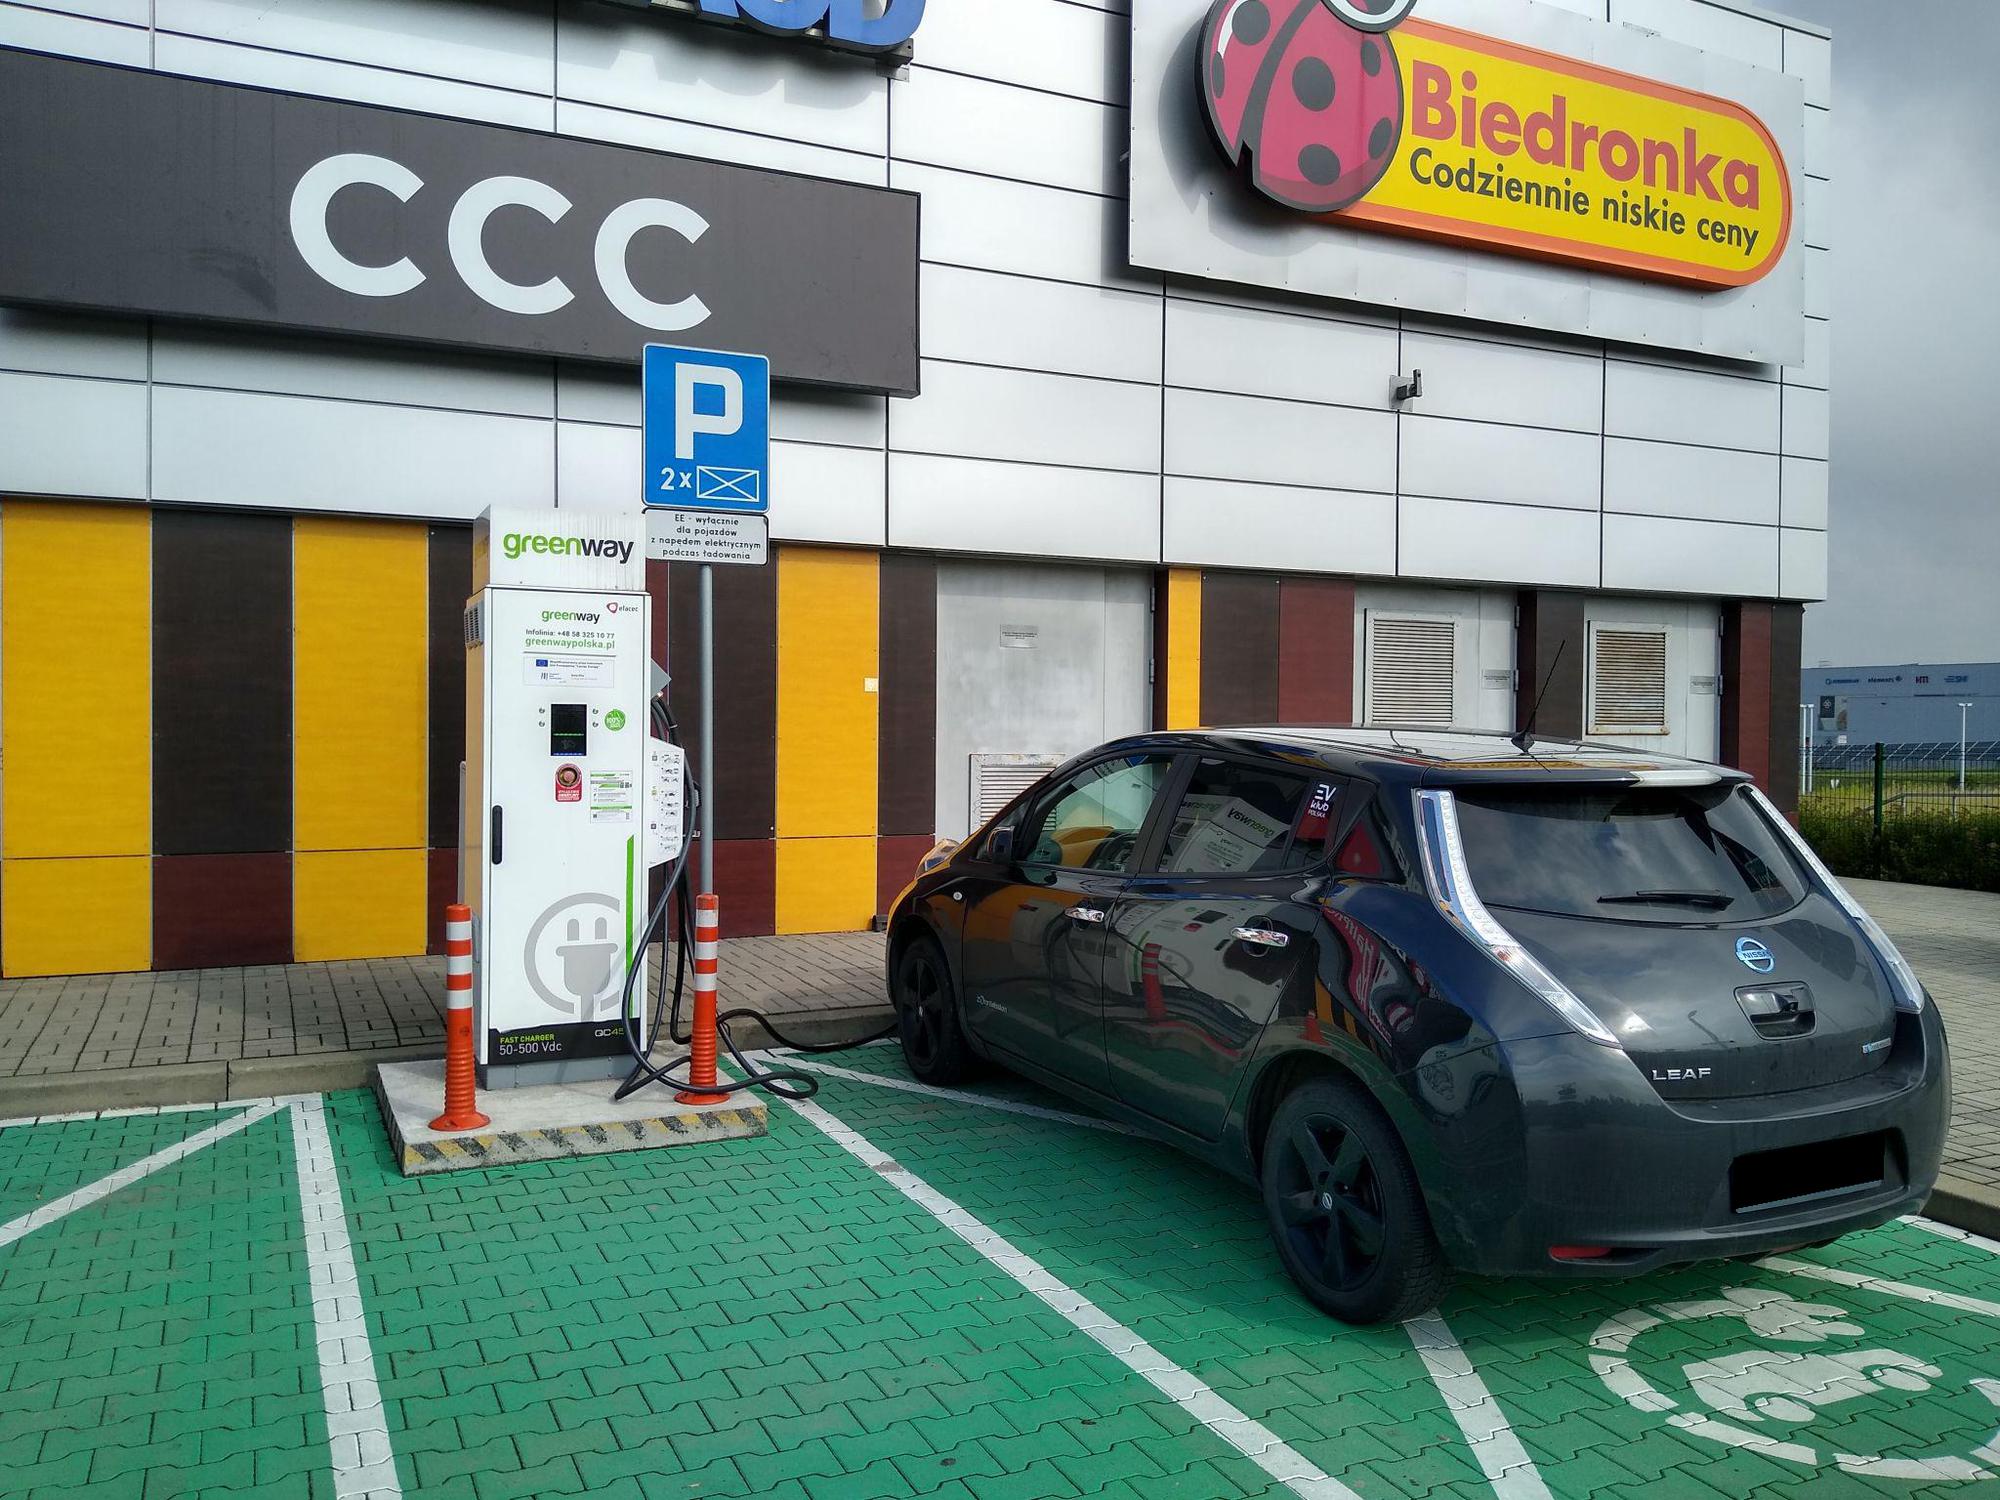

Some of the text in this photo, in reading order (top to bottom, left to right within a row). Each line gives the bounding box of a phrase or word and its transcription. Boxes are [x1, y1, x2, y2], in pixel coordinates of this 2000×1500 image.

[1411, 59, 1760, 211] Biedronka
[1410, 147, 1760, 256] Codziennie niskie ceny
[289, 153, 712, 332] CCC
[675, 362, 744, 460] P
[674, 514, 685, 522] EE
[695, 516, 739, 526] wyłącznie
[676, 526, 691, 534] dla
[503, 533, 635, 564] greenway
[704, 538, 761, 551] elektrycznym
[662, 548, 751, 560] podczas ładowania
[541, 610, 600, 624] greenway
[525, 638, 615, 651] greenwaypolska.pl
[1314, 784, 1337, 801] EV
[500, 1033, 555, 1044] FAST CHARGER
[499, 1041, 562, 1055] 50-500 Vdc
[1652, 1067, 1711, 1081] LEAF
